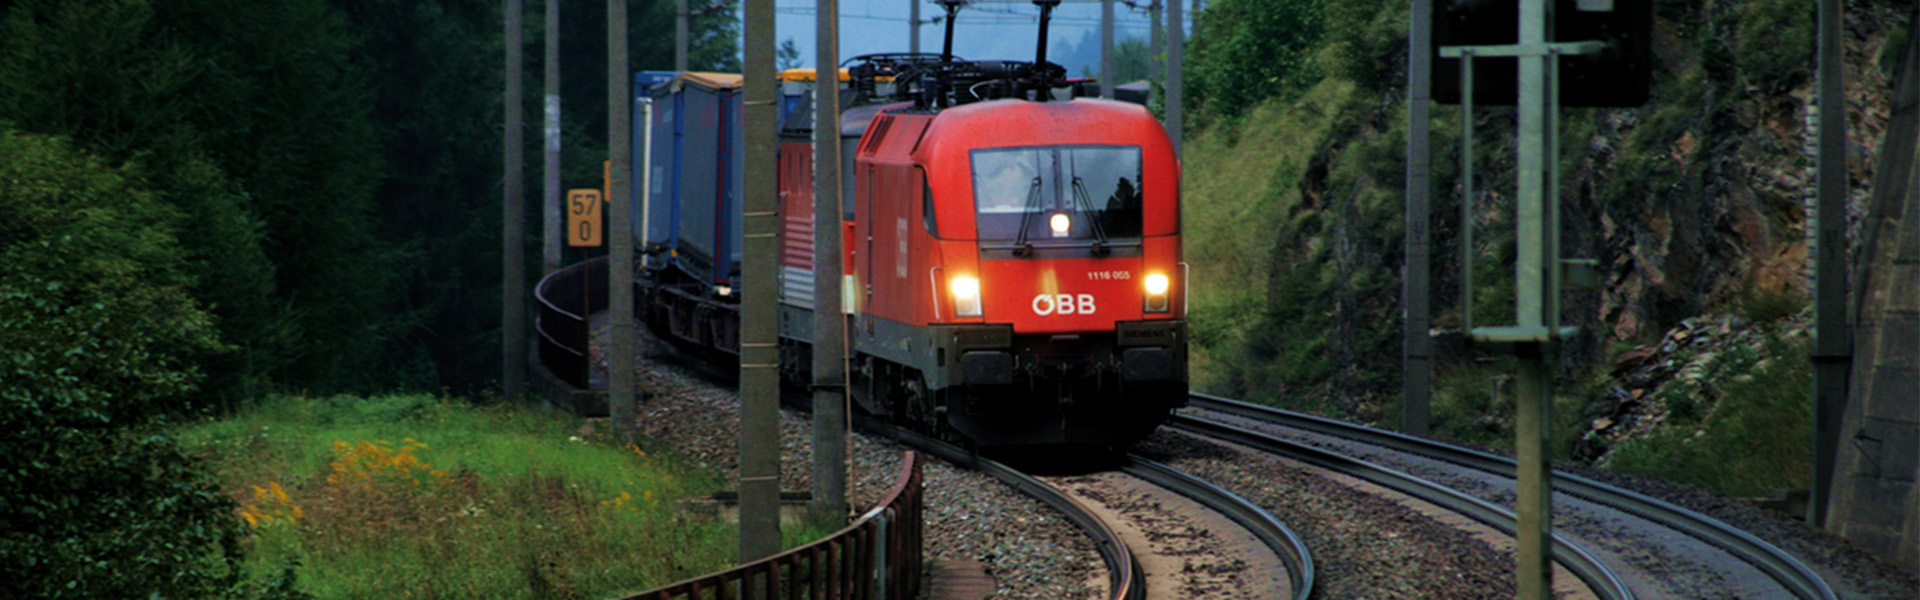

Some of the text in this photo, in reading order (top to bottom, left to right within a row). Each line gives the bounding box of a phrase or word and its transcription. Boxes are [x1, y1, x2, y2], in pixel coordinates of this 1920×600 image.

[573, 194, 596, 215] 57
[579, 221, 591, 241] 0
[1088, 271, 1110, 280] 1116
